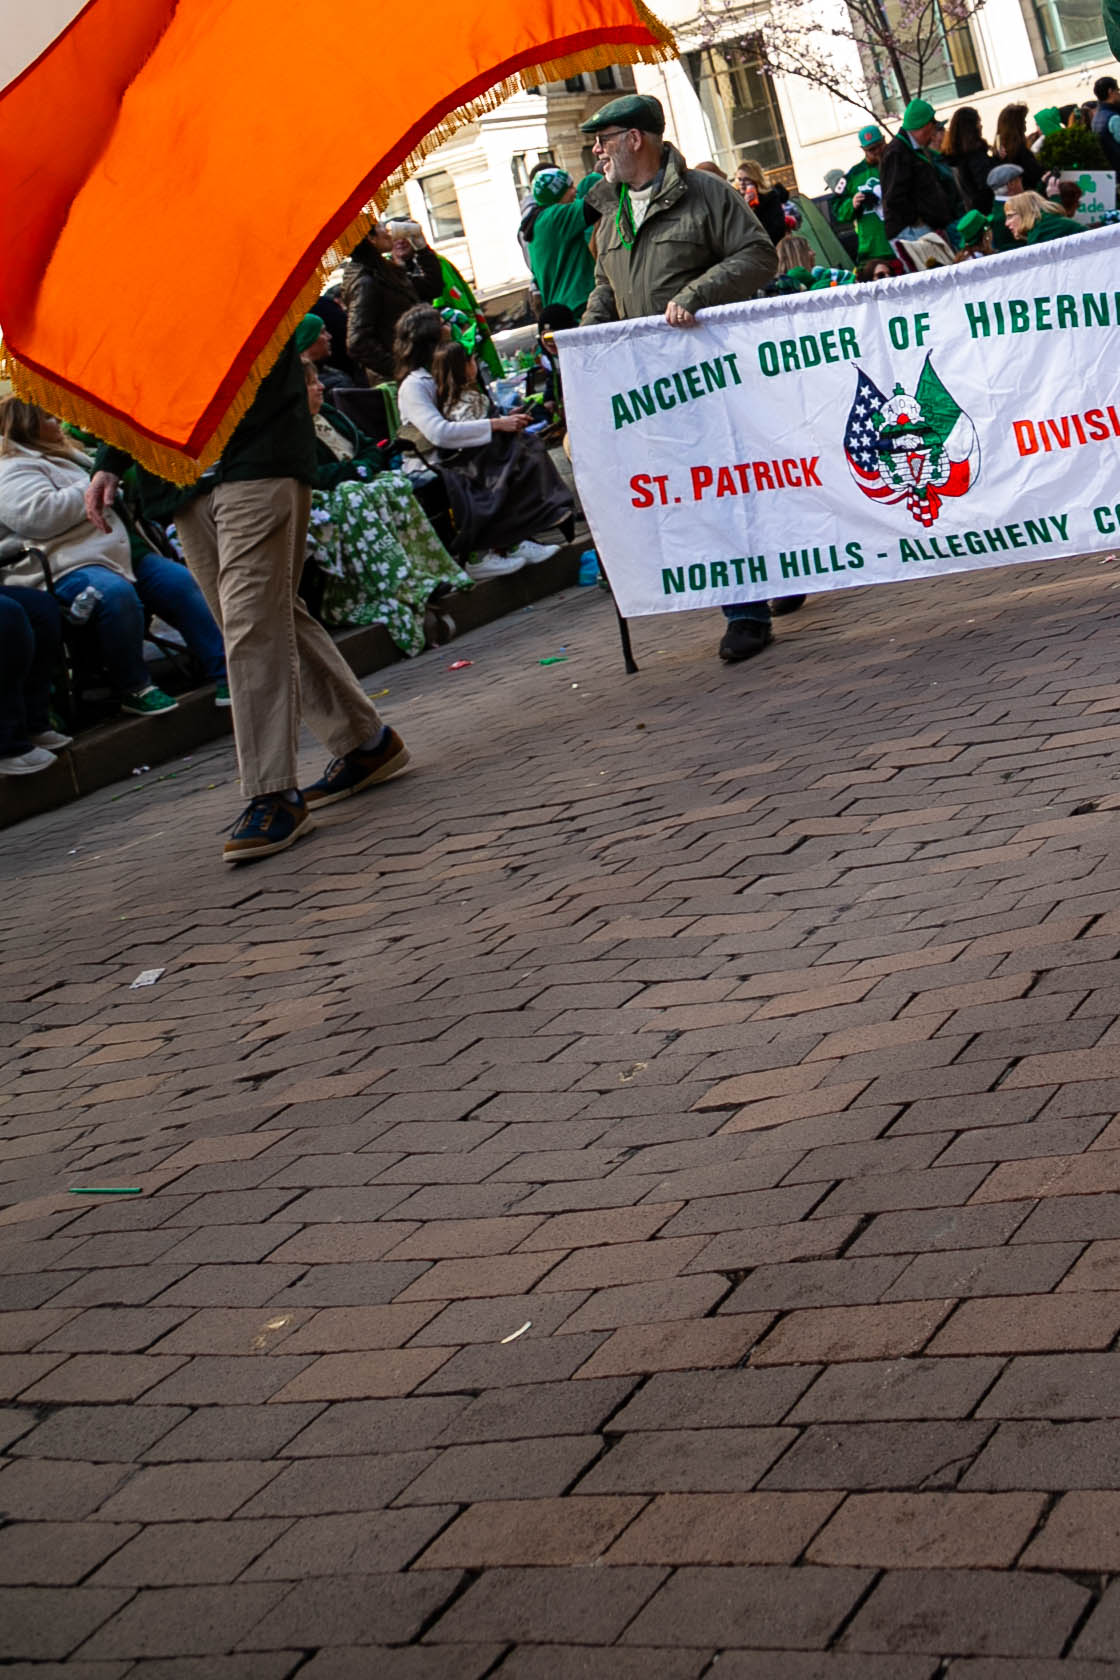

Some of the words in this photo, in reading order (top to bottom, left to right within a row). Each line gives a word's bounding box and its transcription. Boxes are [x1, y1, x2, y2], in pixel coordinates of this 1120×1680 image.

[612, 352, 742, 431] ANCIENT
[757, 326, 862, 378] ORDER
[888, 312, 930, 351] OF
[689, 455, 823, 502] PATRICK
[660, 554, 769, 596] NORTH
[778, 541, 865, 579] HILLS
[898, 513, 1070, 563] ALLEGHENY
